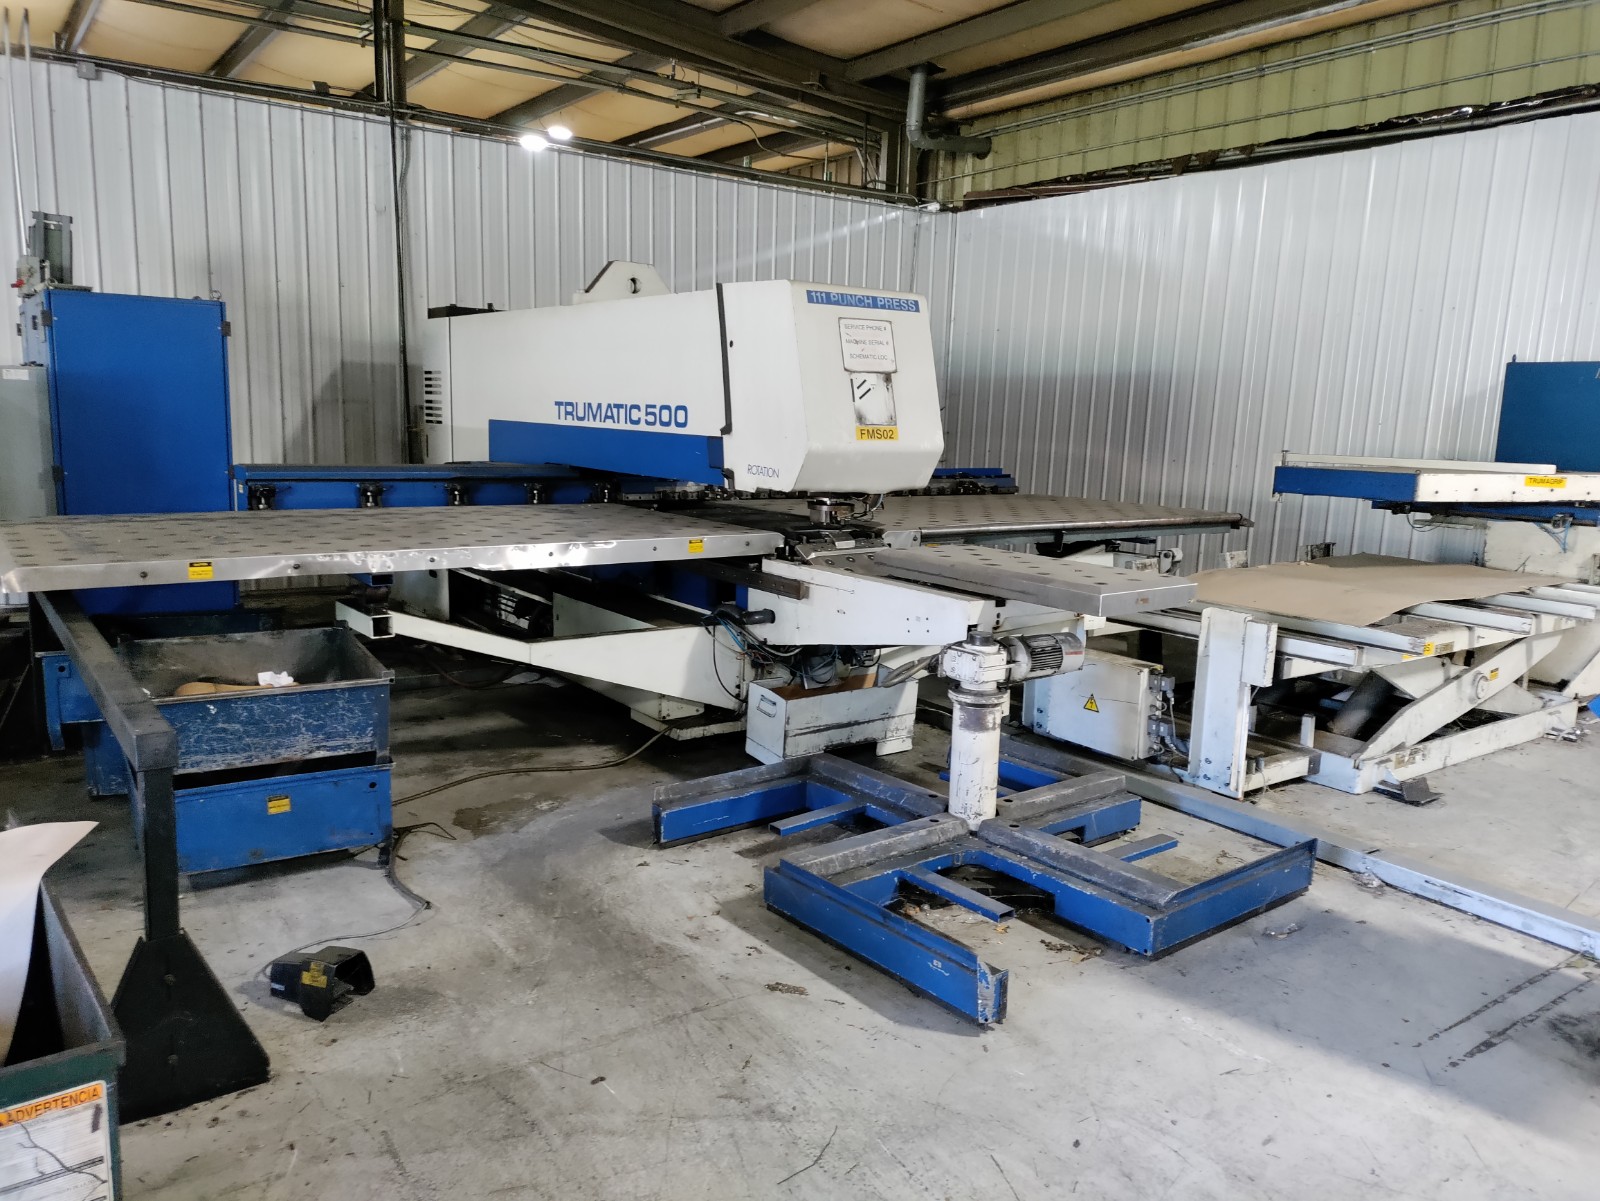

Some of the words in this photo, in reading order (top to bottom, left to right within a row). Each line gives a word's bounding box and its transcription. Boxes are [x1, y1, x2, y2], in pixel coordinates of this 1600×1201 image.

[810, 291, 827, 303] 111
[830, 293, 873, 308] PUNCH
[877, 297, 916, 312] PRESS
[554, 400, 641, 426] TRUMATIC
[644, 404, 689, 429] 500
[860, 428, 895, 440] FMS02
[747, 463, 780, 479] ROTATION
[7, 1087, 100, 1123] ADVERTENCIA
